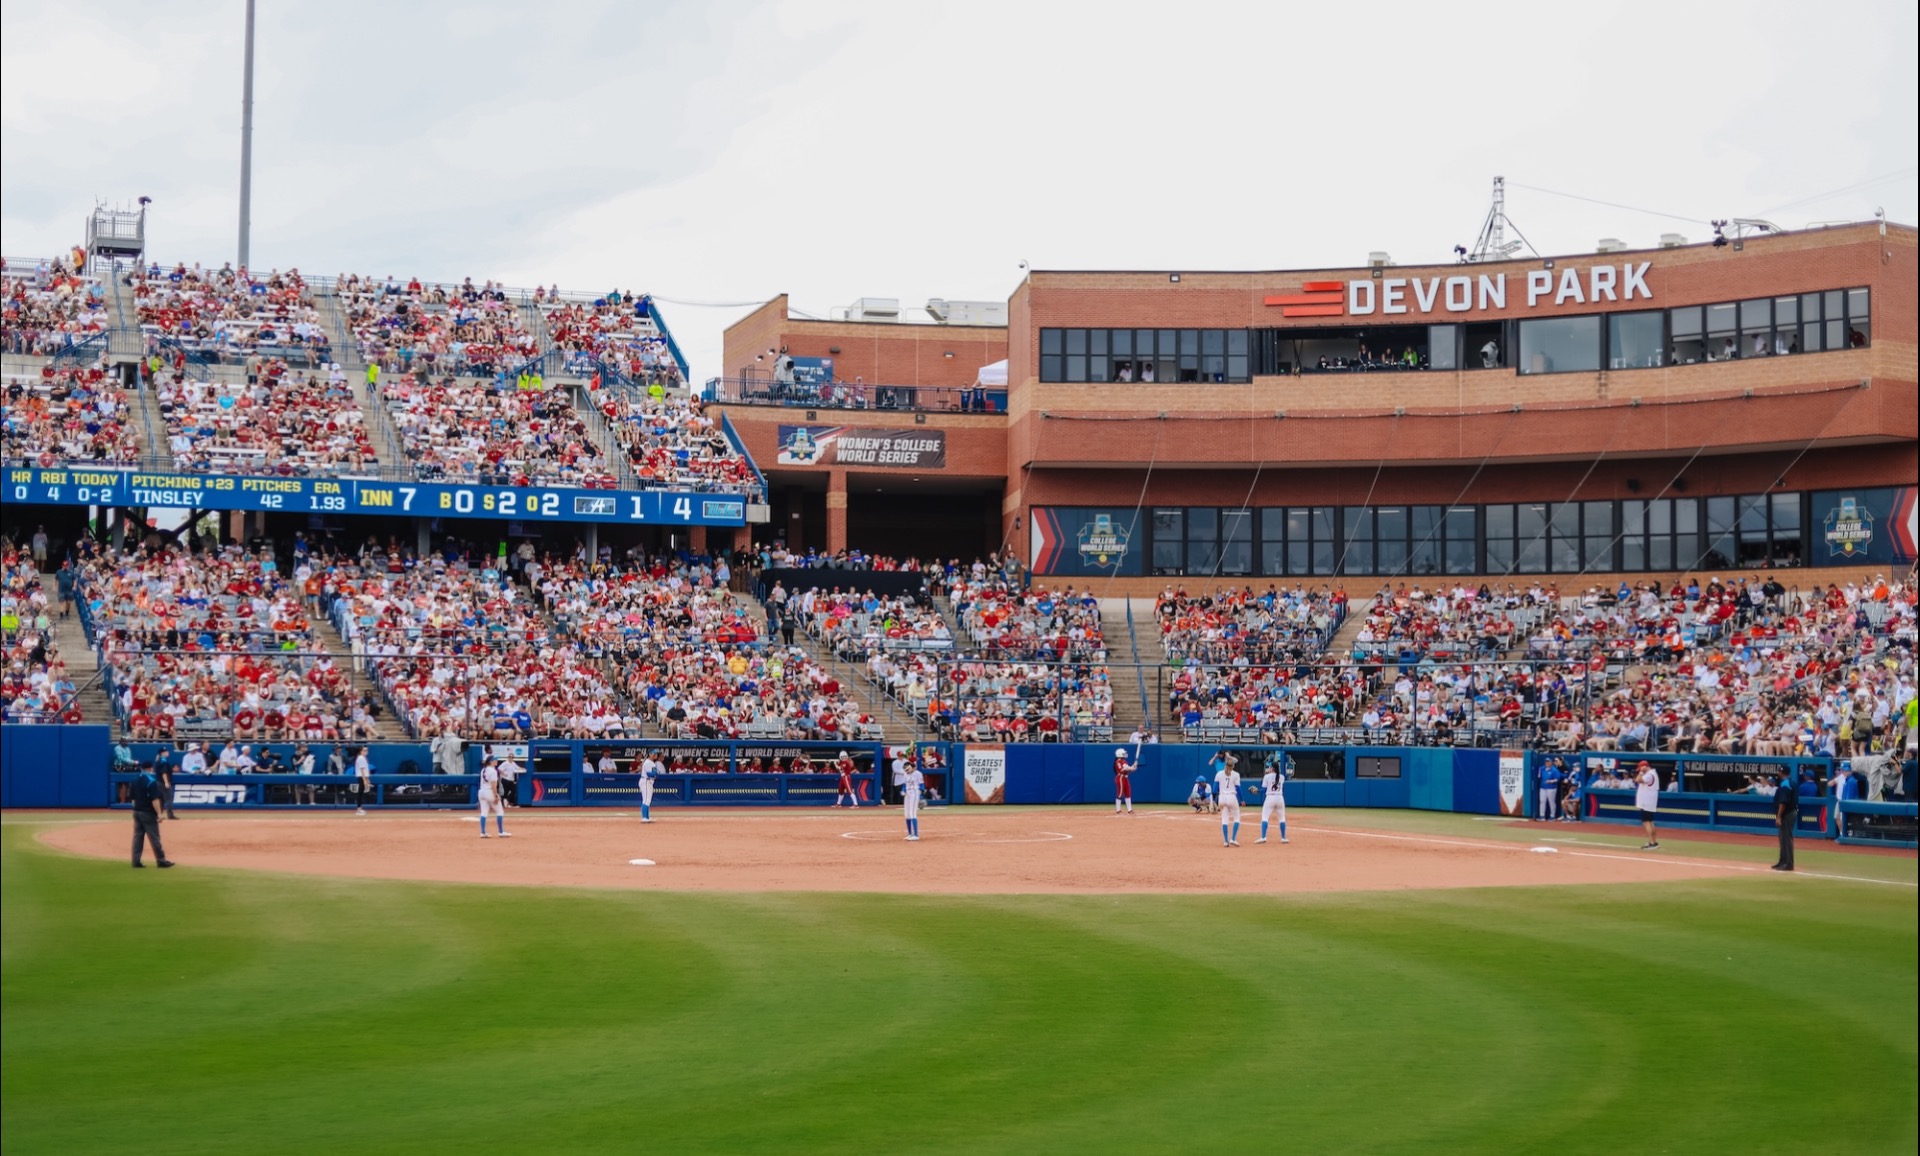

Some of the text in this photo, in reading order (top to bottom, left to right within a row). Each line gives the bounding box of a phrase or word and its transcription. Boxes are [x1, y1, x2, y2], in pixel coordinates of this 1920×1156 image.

[1349, 262, 1653, 315] DEVON PARK
[836, 437, 941, 452] WOMEN'S COLLEGE
[836, 450, 919, 464] WORLD SERIES
[12, 471, 118, 486] HR RBI TODAY
[132, 475, 341, 494] PITCHING #23 PITCHES ERA
[15, 486, 112, 502] 0 4 0-2
[132, 489, 346, 510] TINSLEY 42 1.93
[360, 489, 393, 507] INN
[399, 487, 417, 511] 7
[630, 496, 645, 519] 1
[673, 498, 692, 521] 4
[1836, 523, 1862, 532] COLLEGE
[1827, 531, 1848, 541] WORLD
[1849, 530, 1871, 539] SERIES
[671, 748, 709, 757] WOMEN'S
[745, 748, 773, 757] WORLD
[774, 748, 802, 757] SERIES
[967, 759, 1003, 767] GREATEST
[1734, 763, 1760, 774] COLLEGE
[970, 767, 992, 776] SHOW
[974, 776, 993, 784] DIRT
[173, 784, 247, 804] ESPN
